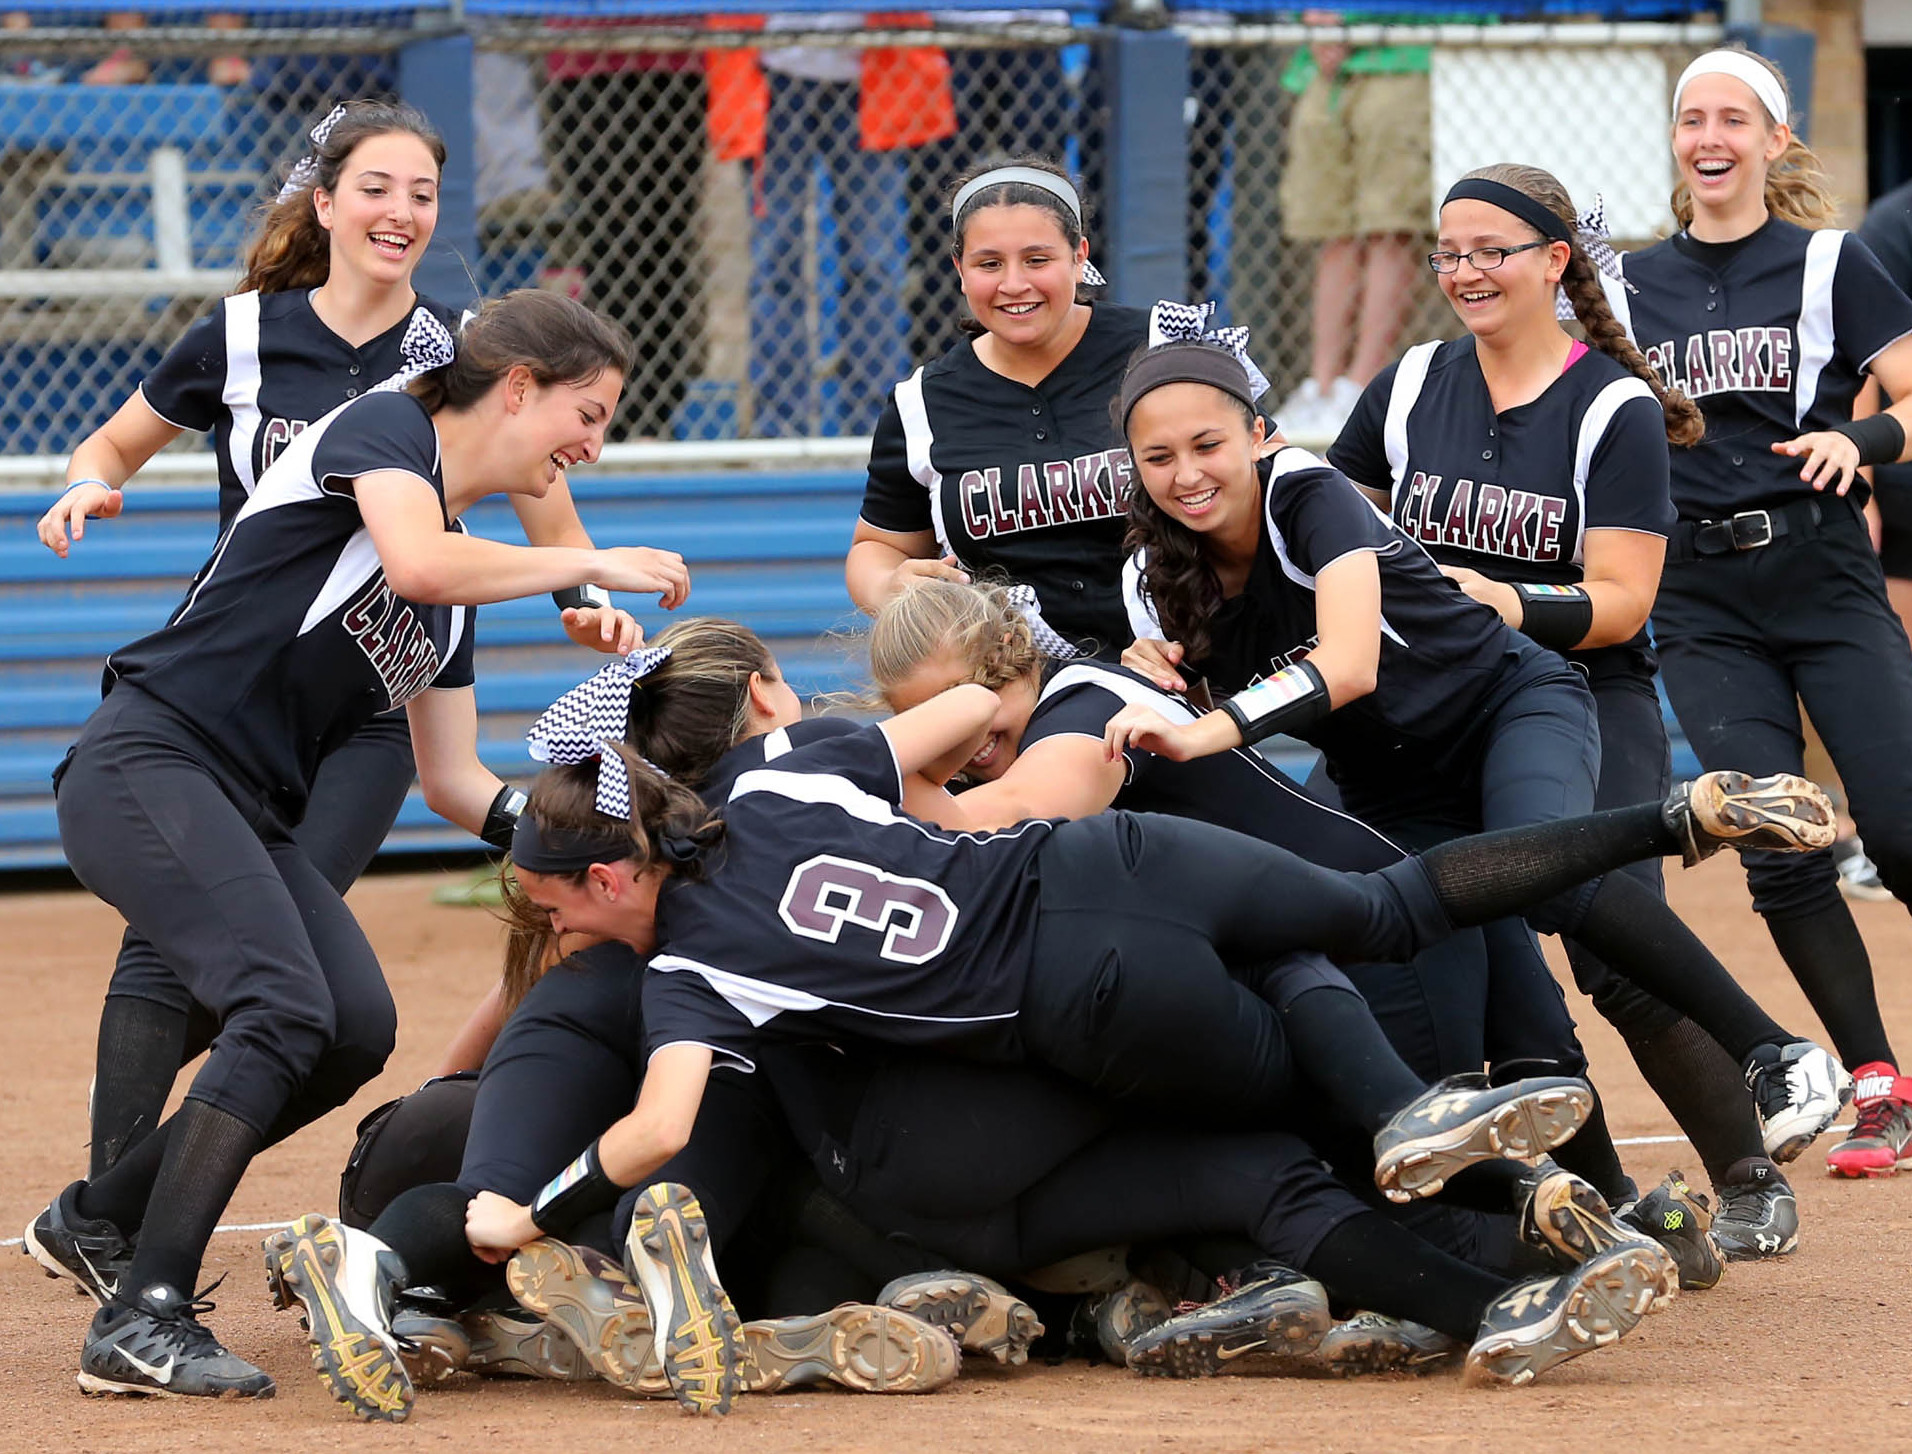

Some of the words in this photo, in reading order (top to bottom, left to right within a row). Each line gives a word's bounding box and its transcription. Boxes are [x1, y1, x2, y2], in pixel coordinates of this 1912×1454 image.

[959, 448, 1133, 541] CLARKE
[1402, 471, 1567, 562] CLARKE
[778, 854, 960, 965] 3
[1856, 1075, 1894, 1100] NIKE
